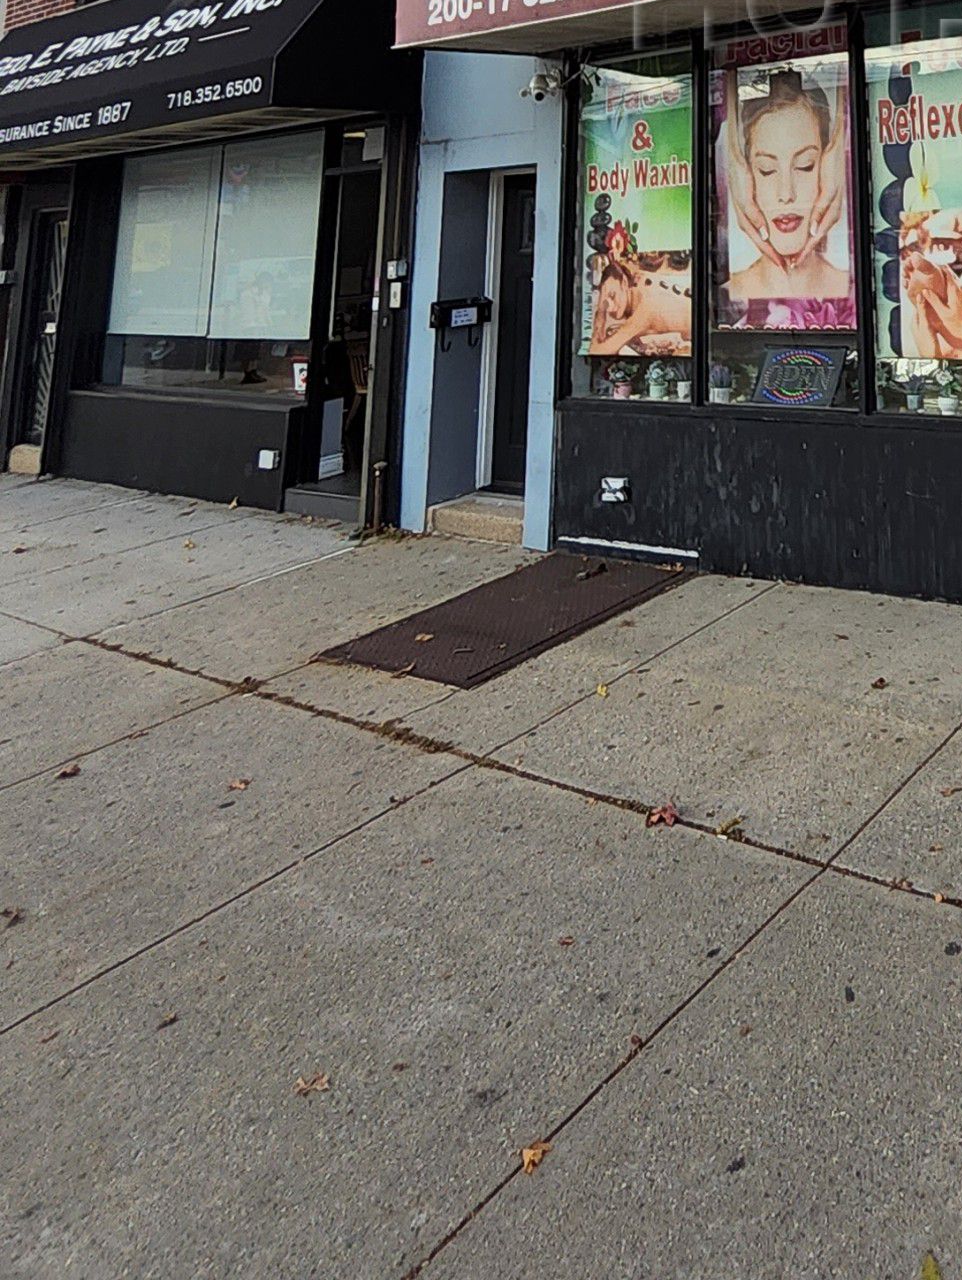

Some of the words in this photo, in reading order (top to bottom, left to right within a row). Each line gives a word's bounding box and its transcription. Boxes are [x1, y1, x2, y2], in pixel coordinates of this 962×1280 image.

[54, 25, 140, 63] PAYNE
[130, 16, 161, 43] &
[153, 2, 223, 37] SON,
[143, 37, 190, 62] LTD.
[167, 76, 262, 109] 718.352.6500
[52, 112, 92, 134] SINCE
[97, 101, 131, 126] 1887
[631, 120, 652, 151] &
[587, 161, 629, 198] Body
